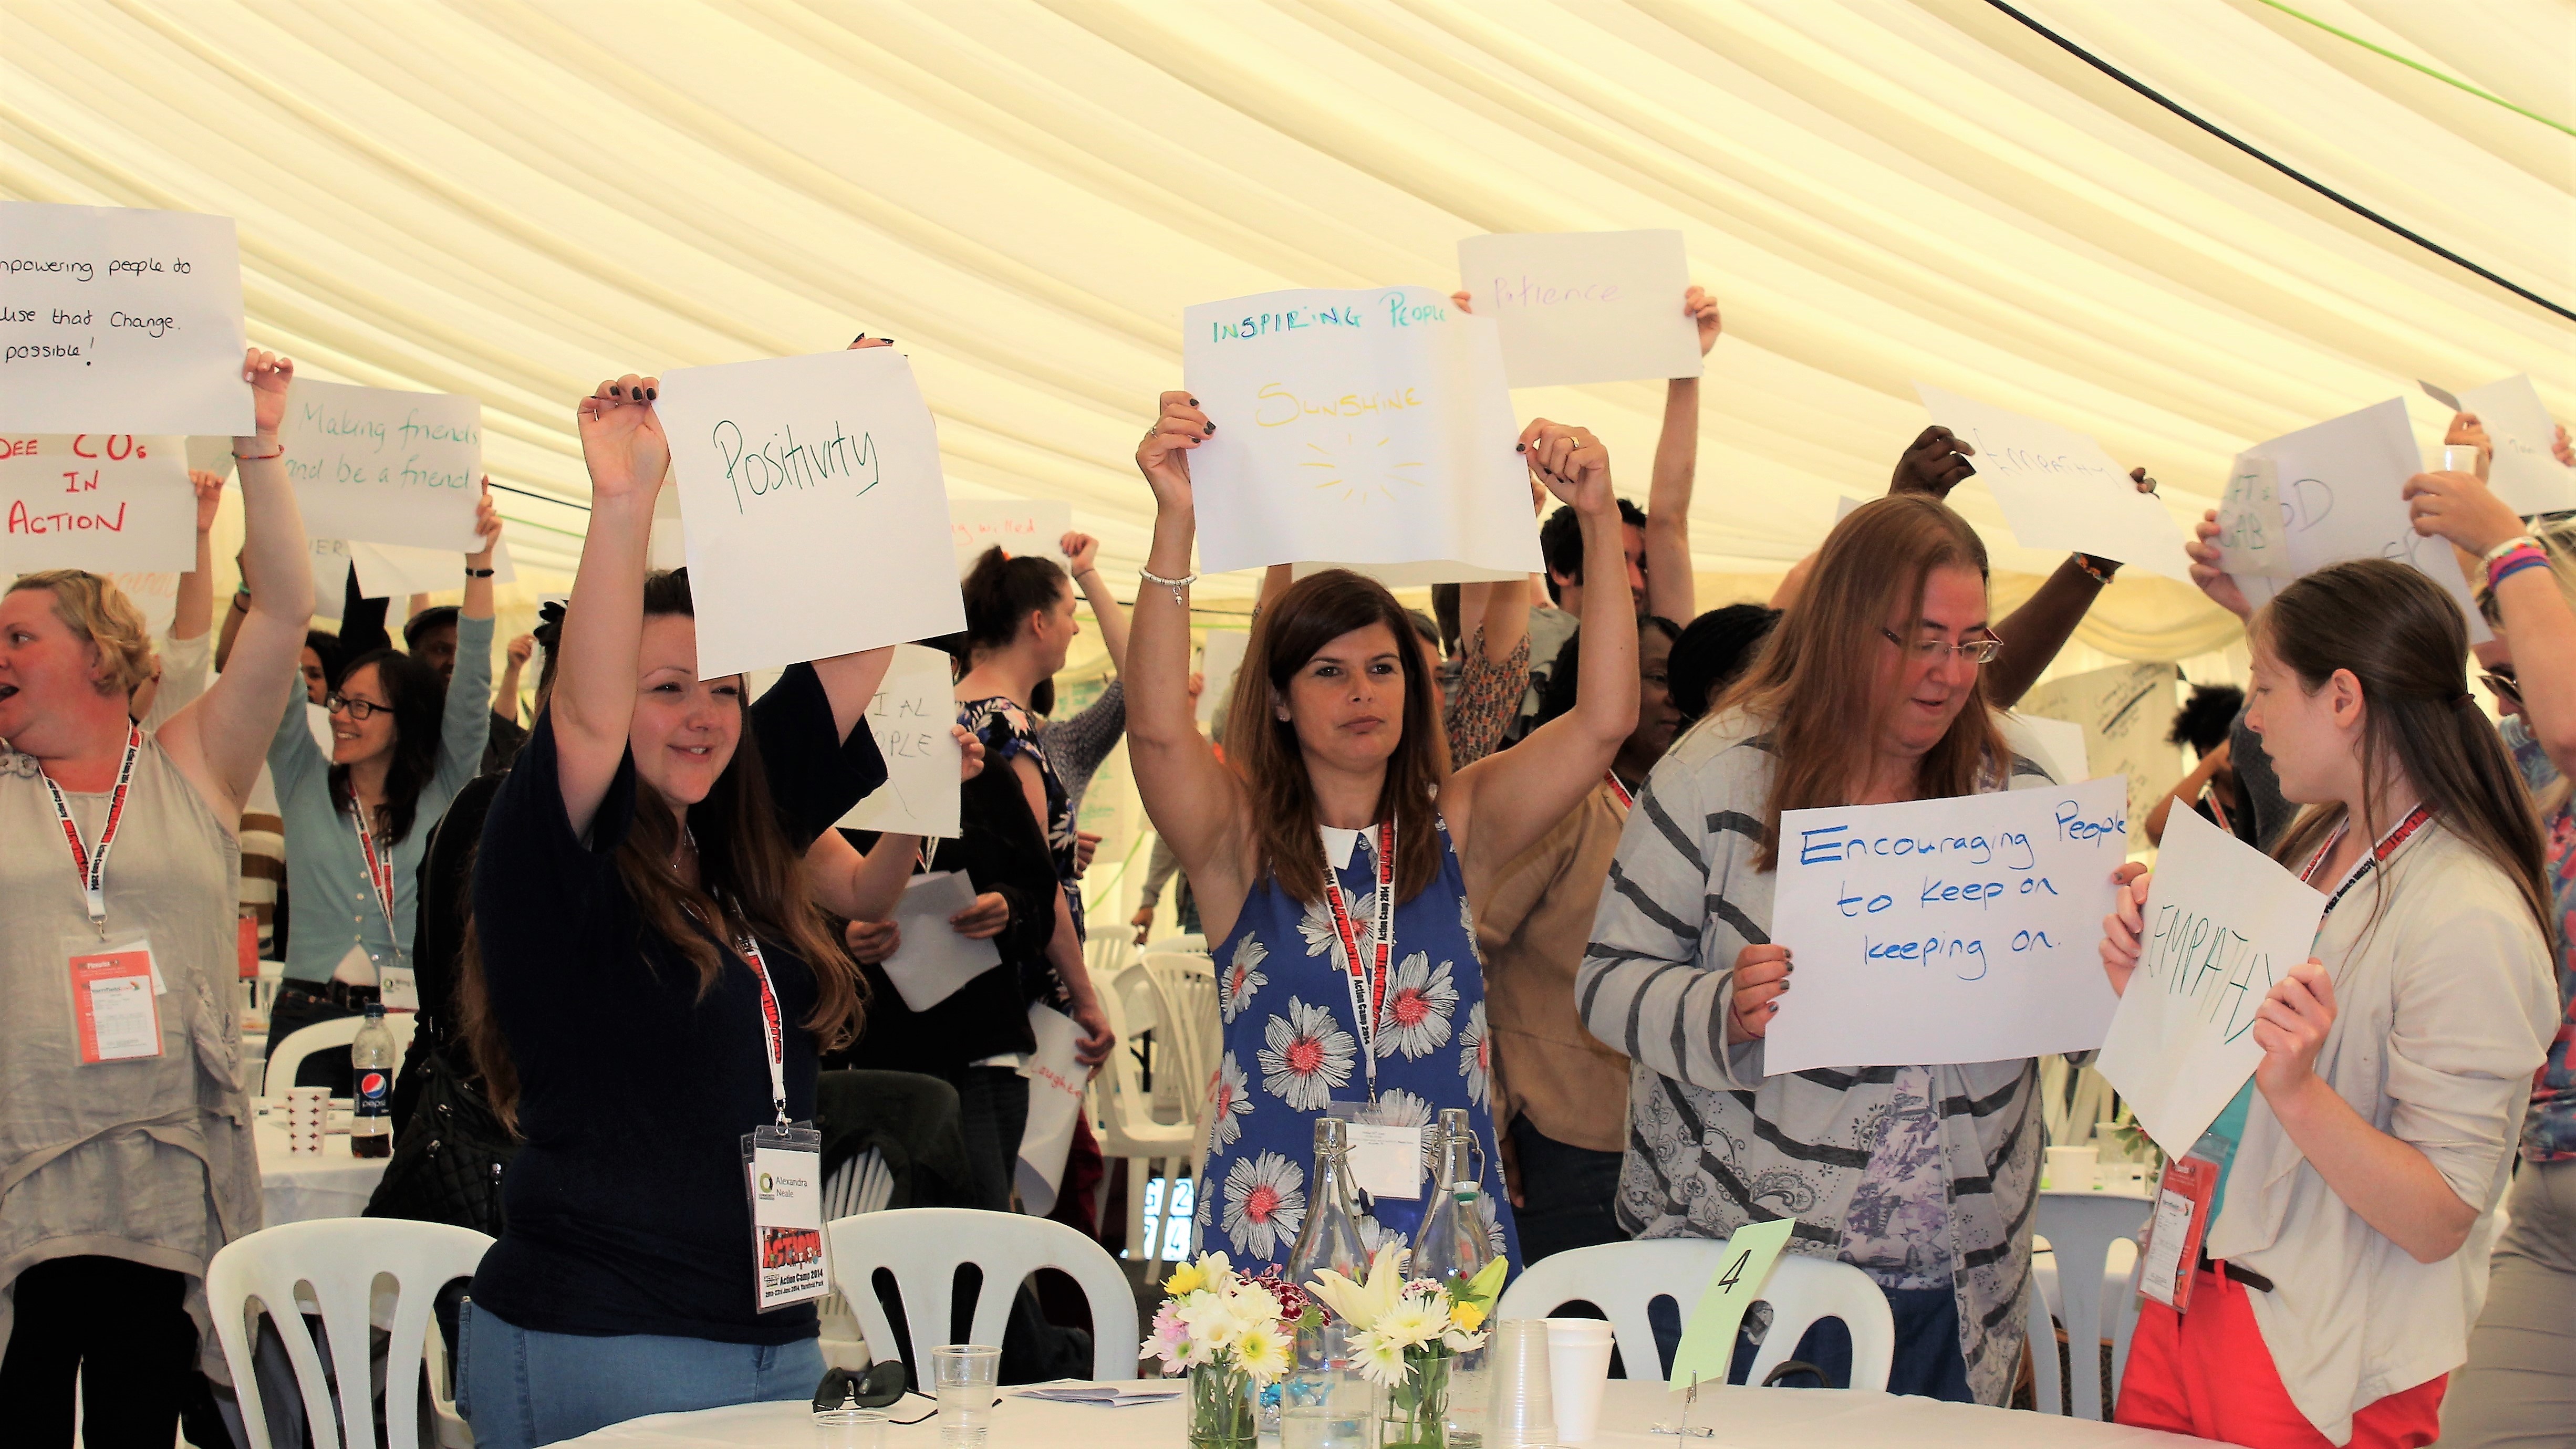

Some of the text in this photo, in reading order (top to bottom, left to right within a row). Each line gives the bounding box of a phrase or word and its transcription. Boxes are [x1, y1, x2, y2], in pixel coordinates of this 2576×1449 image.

[109, 258, 164, 277] people
[1495, 275, 1625, 309] Patience
[53, 306, 93, 325] that
[6, 337, 95, 366] possible!
[298, 402, 387, 454] Making
[337, 455, 367, 484] be
[378, 467, 389, 484] a
[401, 454, 470, 489] friend
[712, 420, 879, 515] Positivity
[63, 470, 99, 493] IN
[8, 499, 126, 534] ACTION
[1800, 799, 2127, 870] Encouraging People
[1380, 886, 1390, 902] 2014
[1837, 875, 2059, 917] to keep on
[1379, 903, 1389, 920] Camp
[1378, 920, 1388, 941] Action
[1864, 930, 2062, 981] keeping on.
[1354, 979, 1365, 1004] Action
[1358, 1004, 1367, 1025] Camp
[776, 1176, 807, 1187] Alexandra
[776, 1189, 794, 1198] Neale
[780, 1275, 796, 1286] Action
[796, 1272, 811, 1283] Camp
[811, 1268, 823, 1279] 2014
[1718, 1249, 1752, 1294] 4
